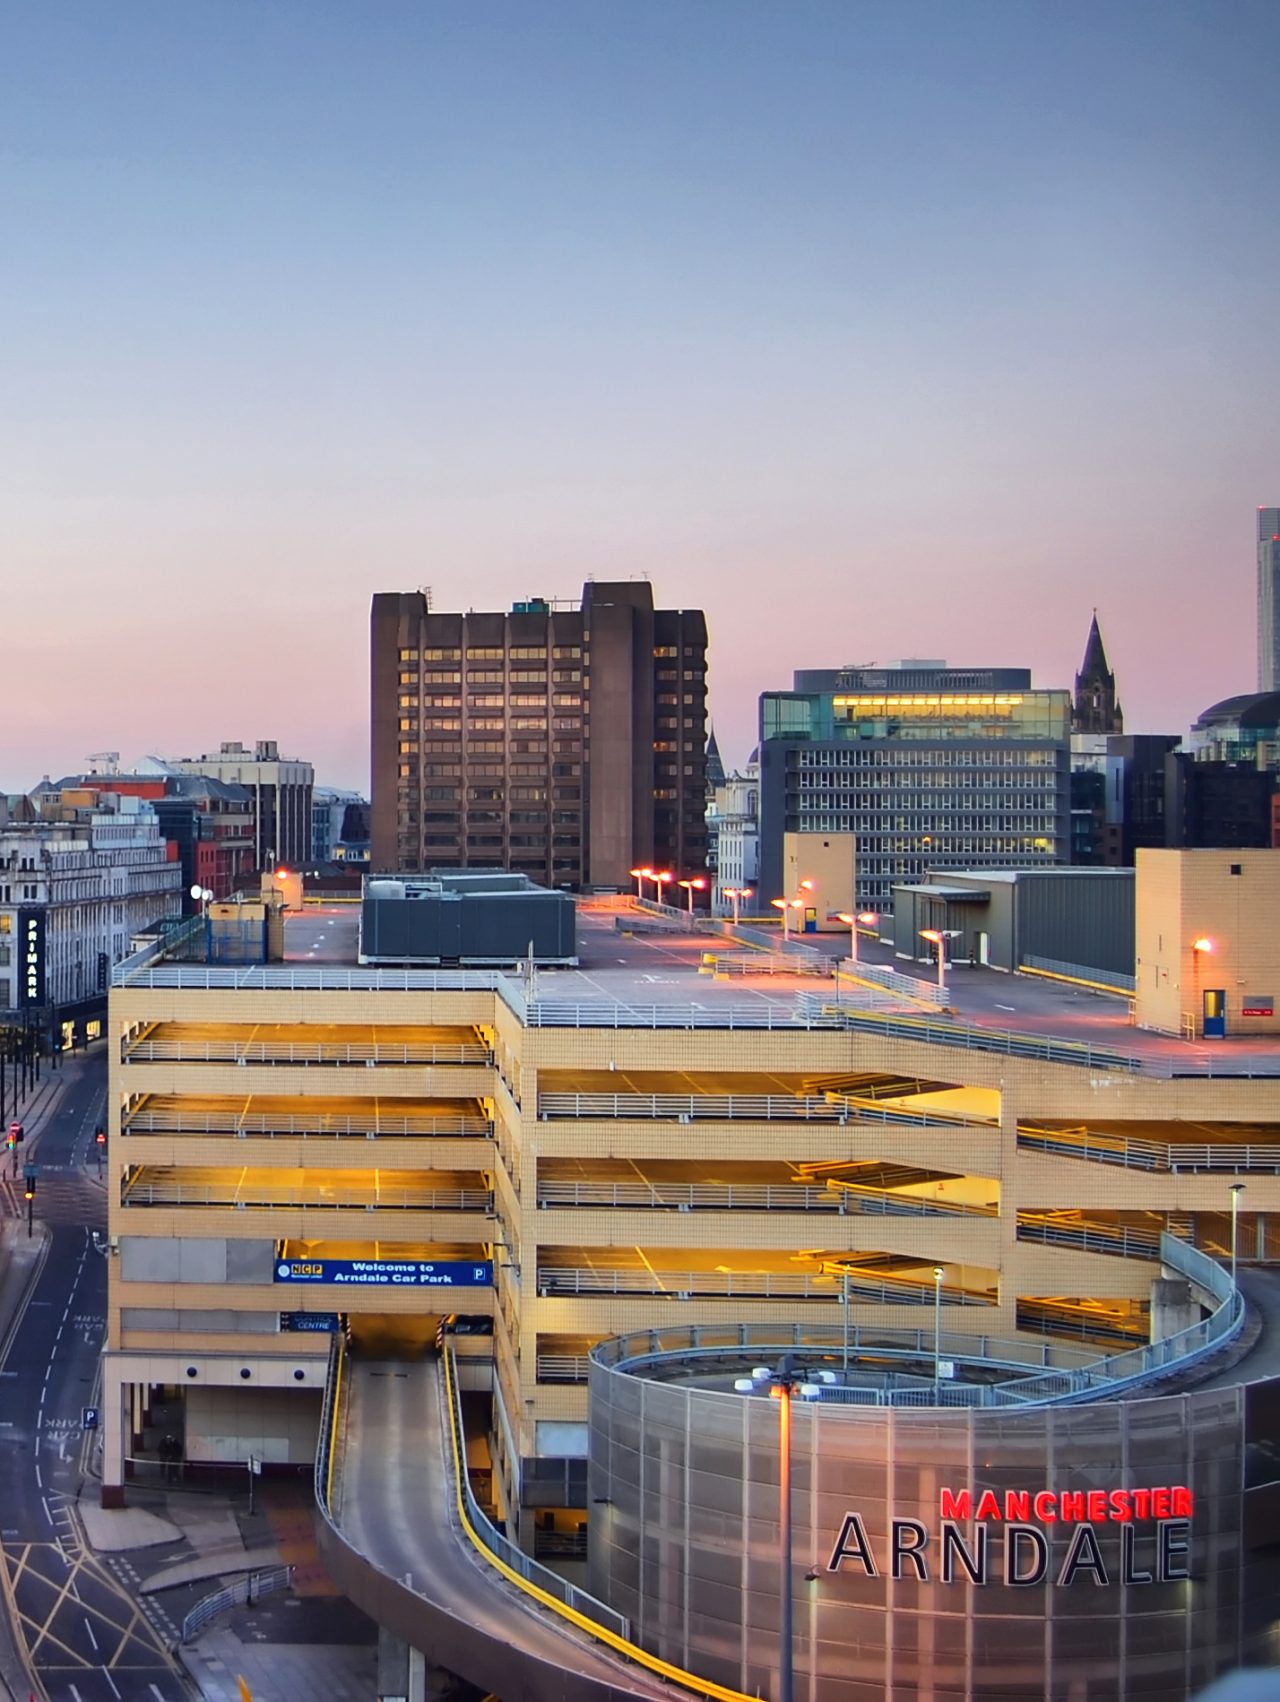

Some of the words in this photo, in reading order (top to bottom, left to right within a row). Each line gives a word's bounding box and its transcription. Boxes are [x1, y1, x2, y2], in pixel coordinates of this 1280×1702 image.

[26, 919, 38, 998] PRIMARK
[291, 1264, 322, 1274] NCP
[352, 1262, 416, 1272] Welcome
[419, 1263, 434, 1272] to
[334, 1273, 389, 1283] Arndale
[392, 1274, 417, 1283] Car
[420, 1274, 452, 1284] Park
[297, 1321, 330, 1330] CENTRE
[939, 1485, 1194, 1522] MANCHESTER
[825, 1510, 1193, 1587] ARNDALE
